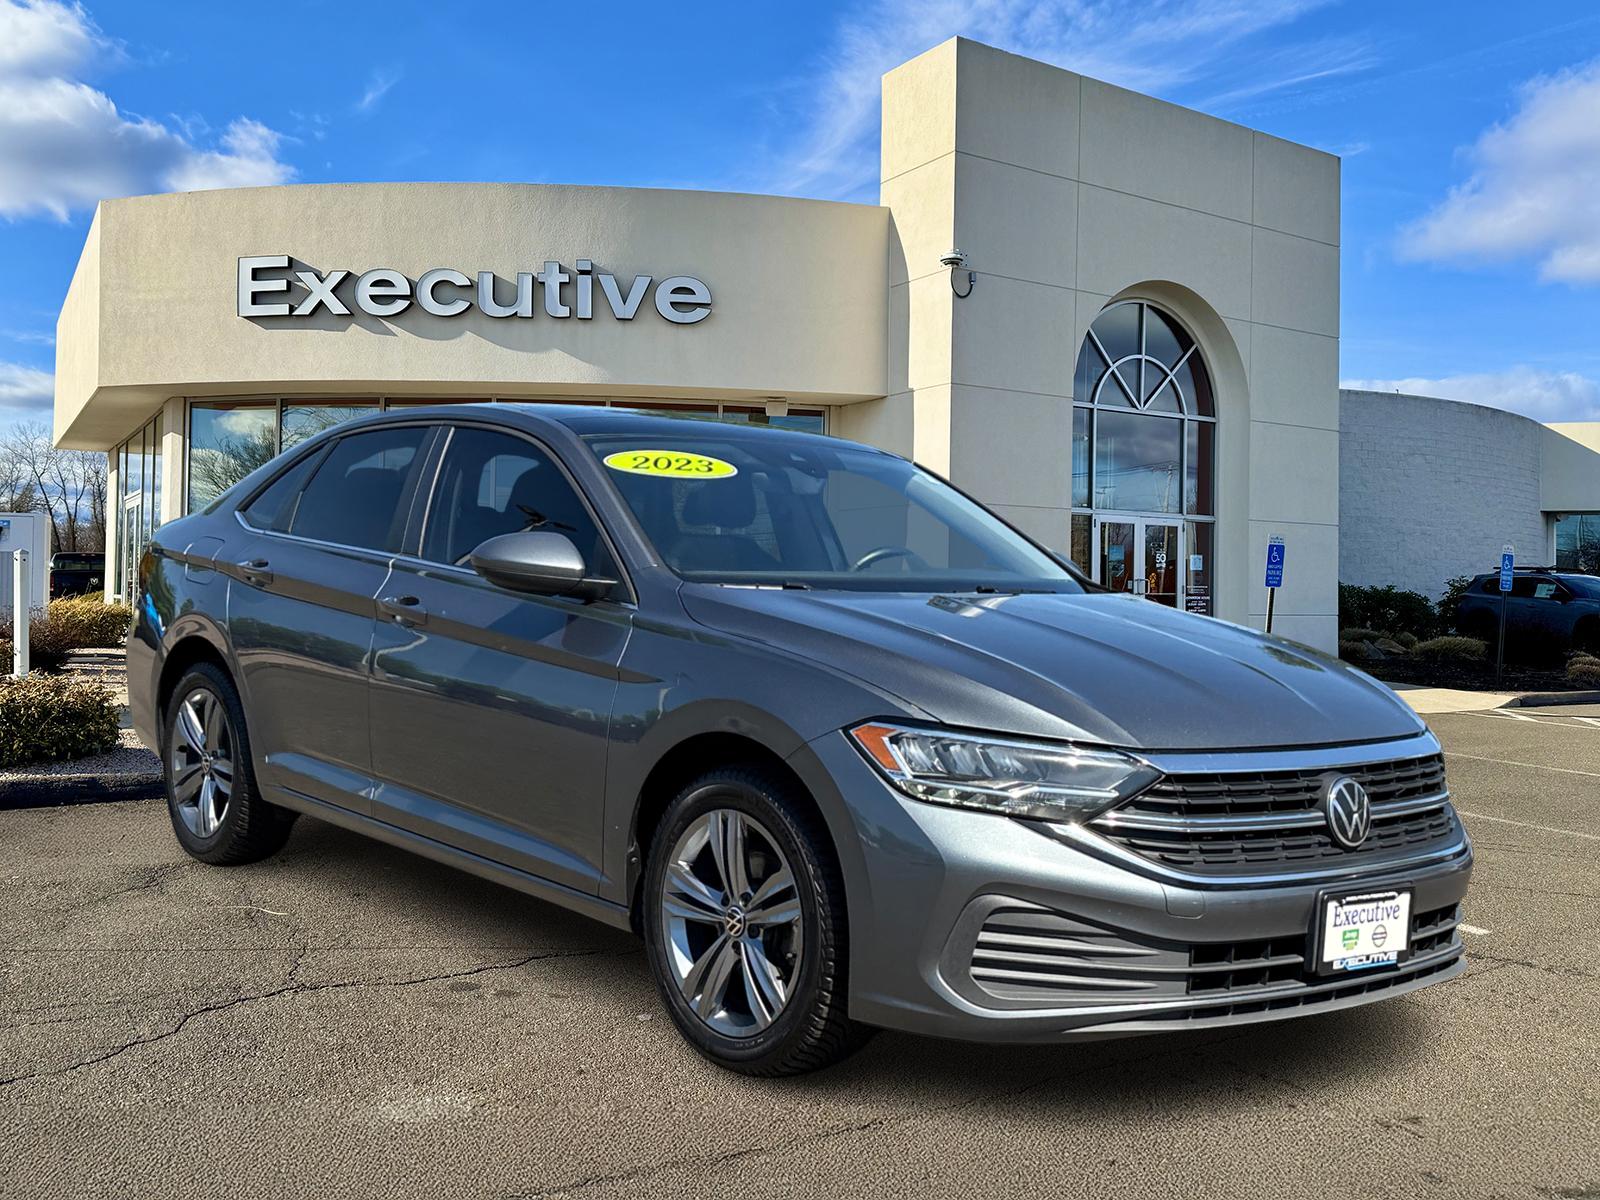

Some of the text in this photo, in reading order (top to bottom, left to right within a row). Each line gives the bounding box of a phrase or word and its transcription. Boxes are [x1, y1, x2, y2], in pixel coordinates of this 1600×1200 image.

[237, 255, 712, 324] Executive
[632, 455, 714, 473] 2023
[1155, 553, 1167, 563] 50
[1333, 901, 1400, 927] Executive
[1332, 951, 1398, 970] EXECUTIVE
